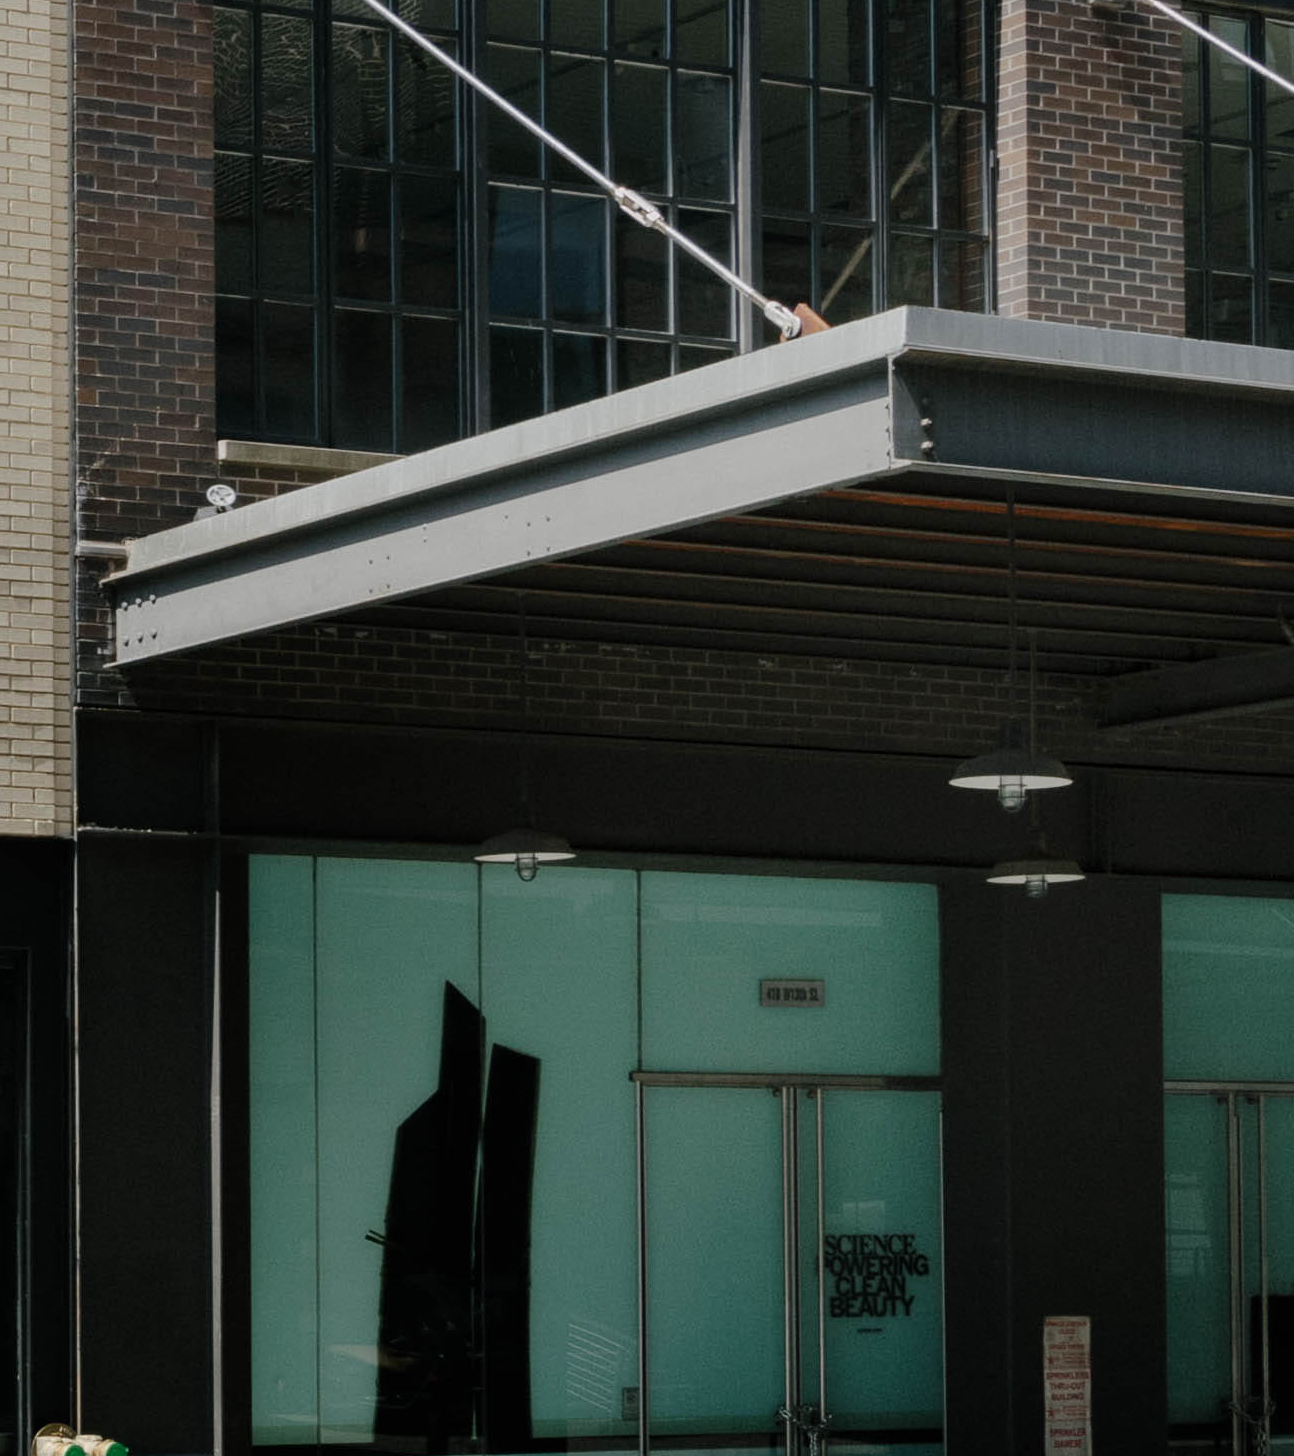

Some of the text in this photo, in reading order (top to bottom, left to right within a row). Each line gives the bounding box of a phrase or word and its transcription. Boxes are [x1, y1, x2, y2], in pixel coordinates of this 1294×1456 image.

[825, 1233, 916, 1256] SCIENCE
[835, 1275, 906, 1296] CLEAN
[829, 1295, 915, 1318] BEAUTY
